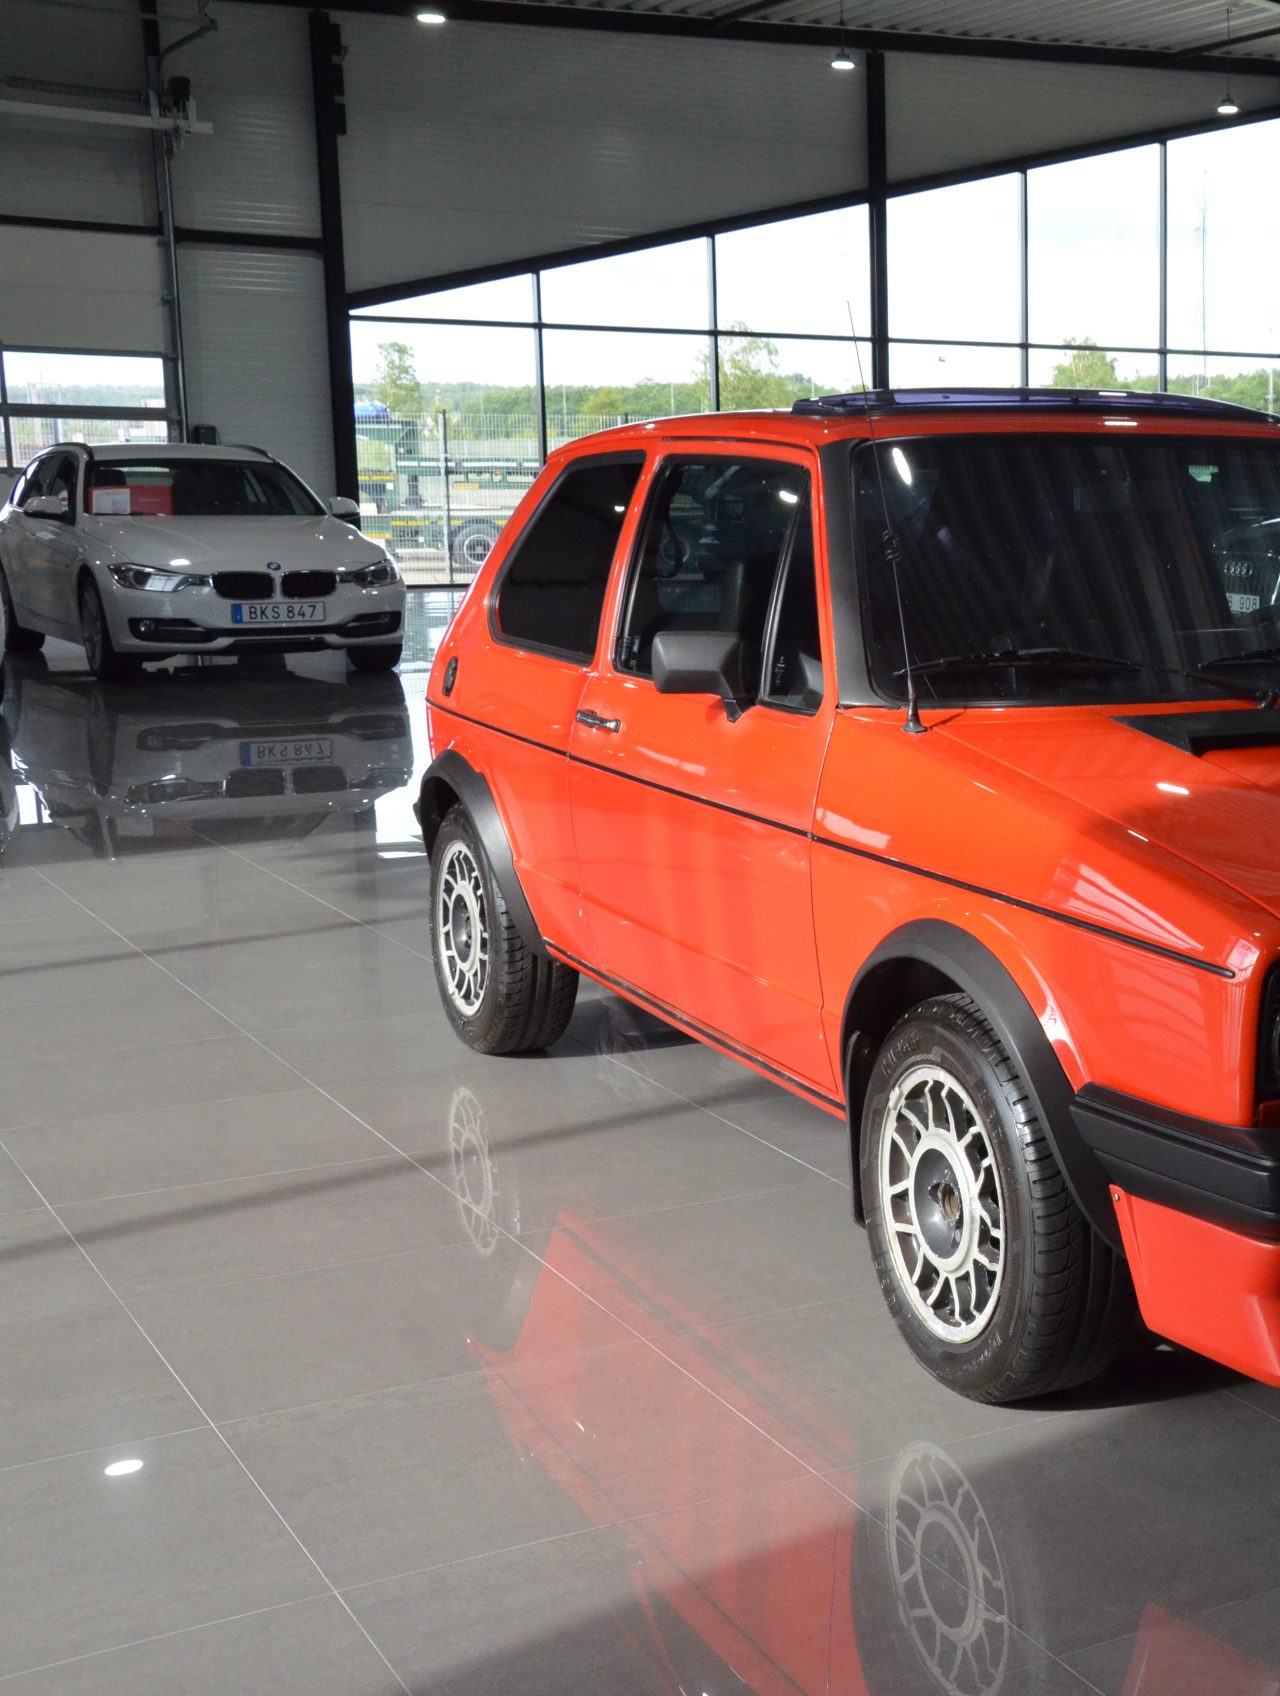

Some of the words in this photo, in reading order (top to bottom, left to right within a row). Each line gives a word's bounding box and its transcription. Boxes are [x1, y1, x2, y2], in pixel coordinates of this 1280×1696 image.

[1239, 596, 1257, 610] 908
[248, 605, 281, 620] BKS
[286, 604, 317, 619] 847
